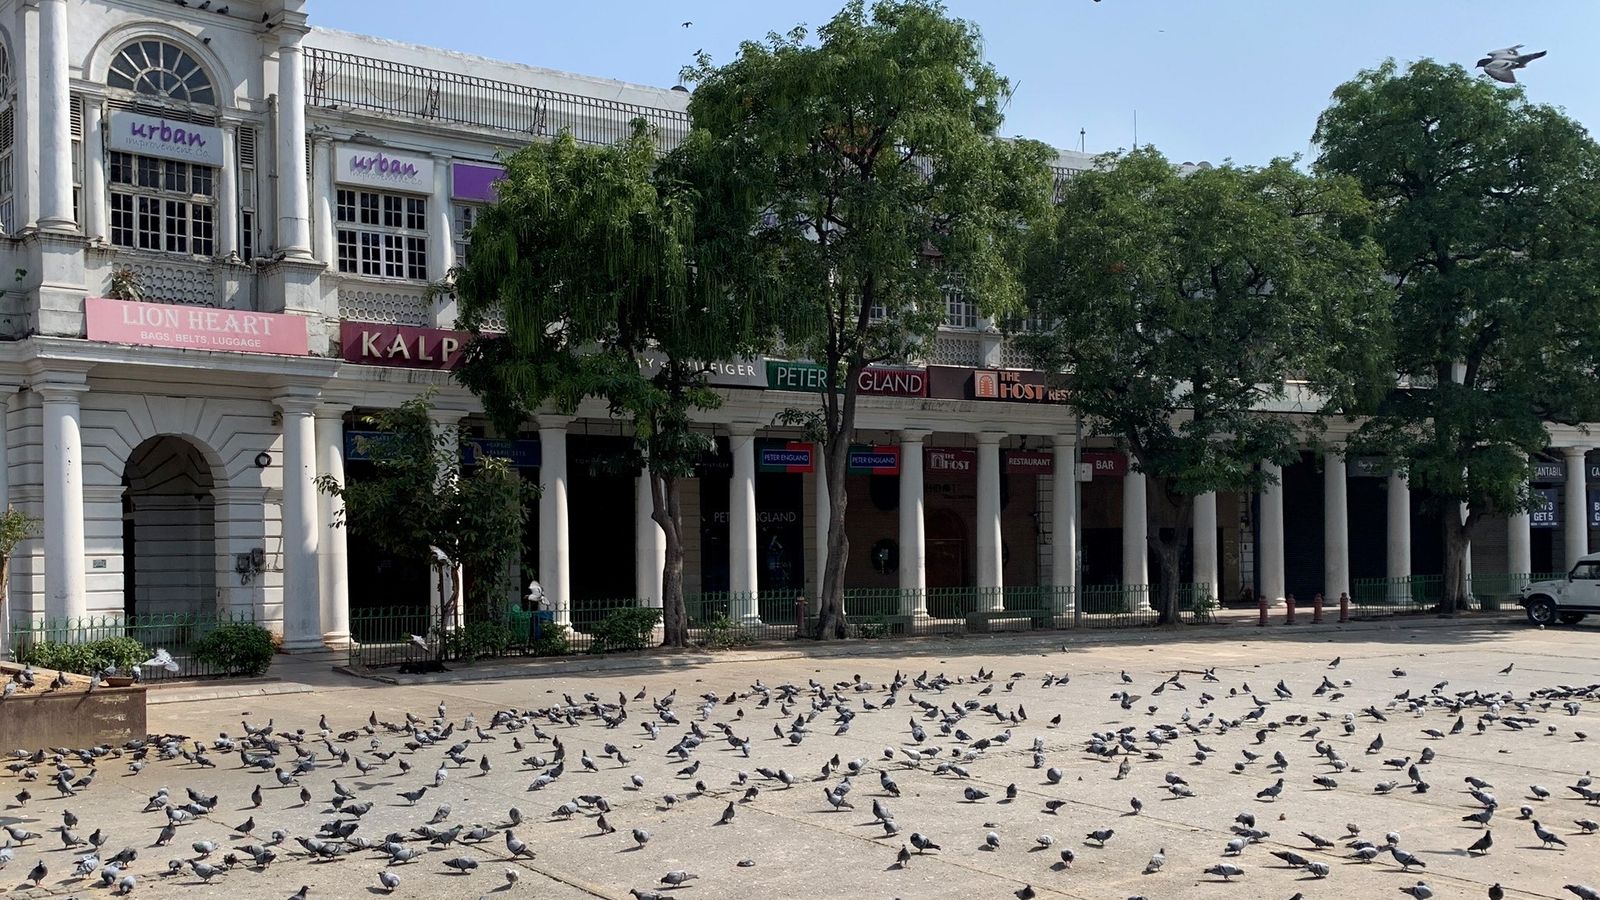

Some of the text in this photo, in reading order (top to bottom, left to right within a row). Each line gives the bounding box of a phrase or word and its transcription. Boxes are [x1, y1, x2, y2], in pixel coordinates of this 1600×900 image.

[131, 120, 206, 147] urban
[352, 152, 418, 175] urban
[121, 304, 274, 336] LION HEART
[212, 336, 262, 348] LUGGAGE
[362, 331, 470, 363] KALP
[777, 366, 923, 393] PETER GLAND
[1000, 372, 1020, 382] THE
[1000, 383, 1045, 400] HOST
[780, 454, 809, 462] ENGLAND
[1008, 457, 1051, 466] RESTAURANT
[944, 460, 970, 470] HOST
[1095, 459, 1114, 470] BAR
[1534, 512, 1553, 520] GET 5
